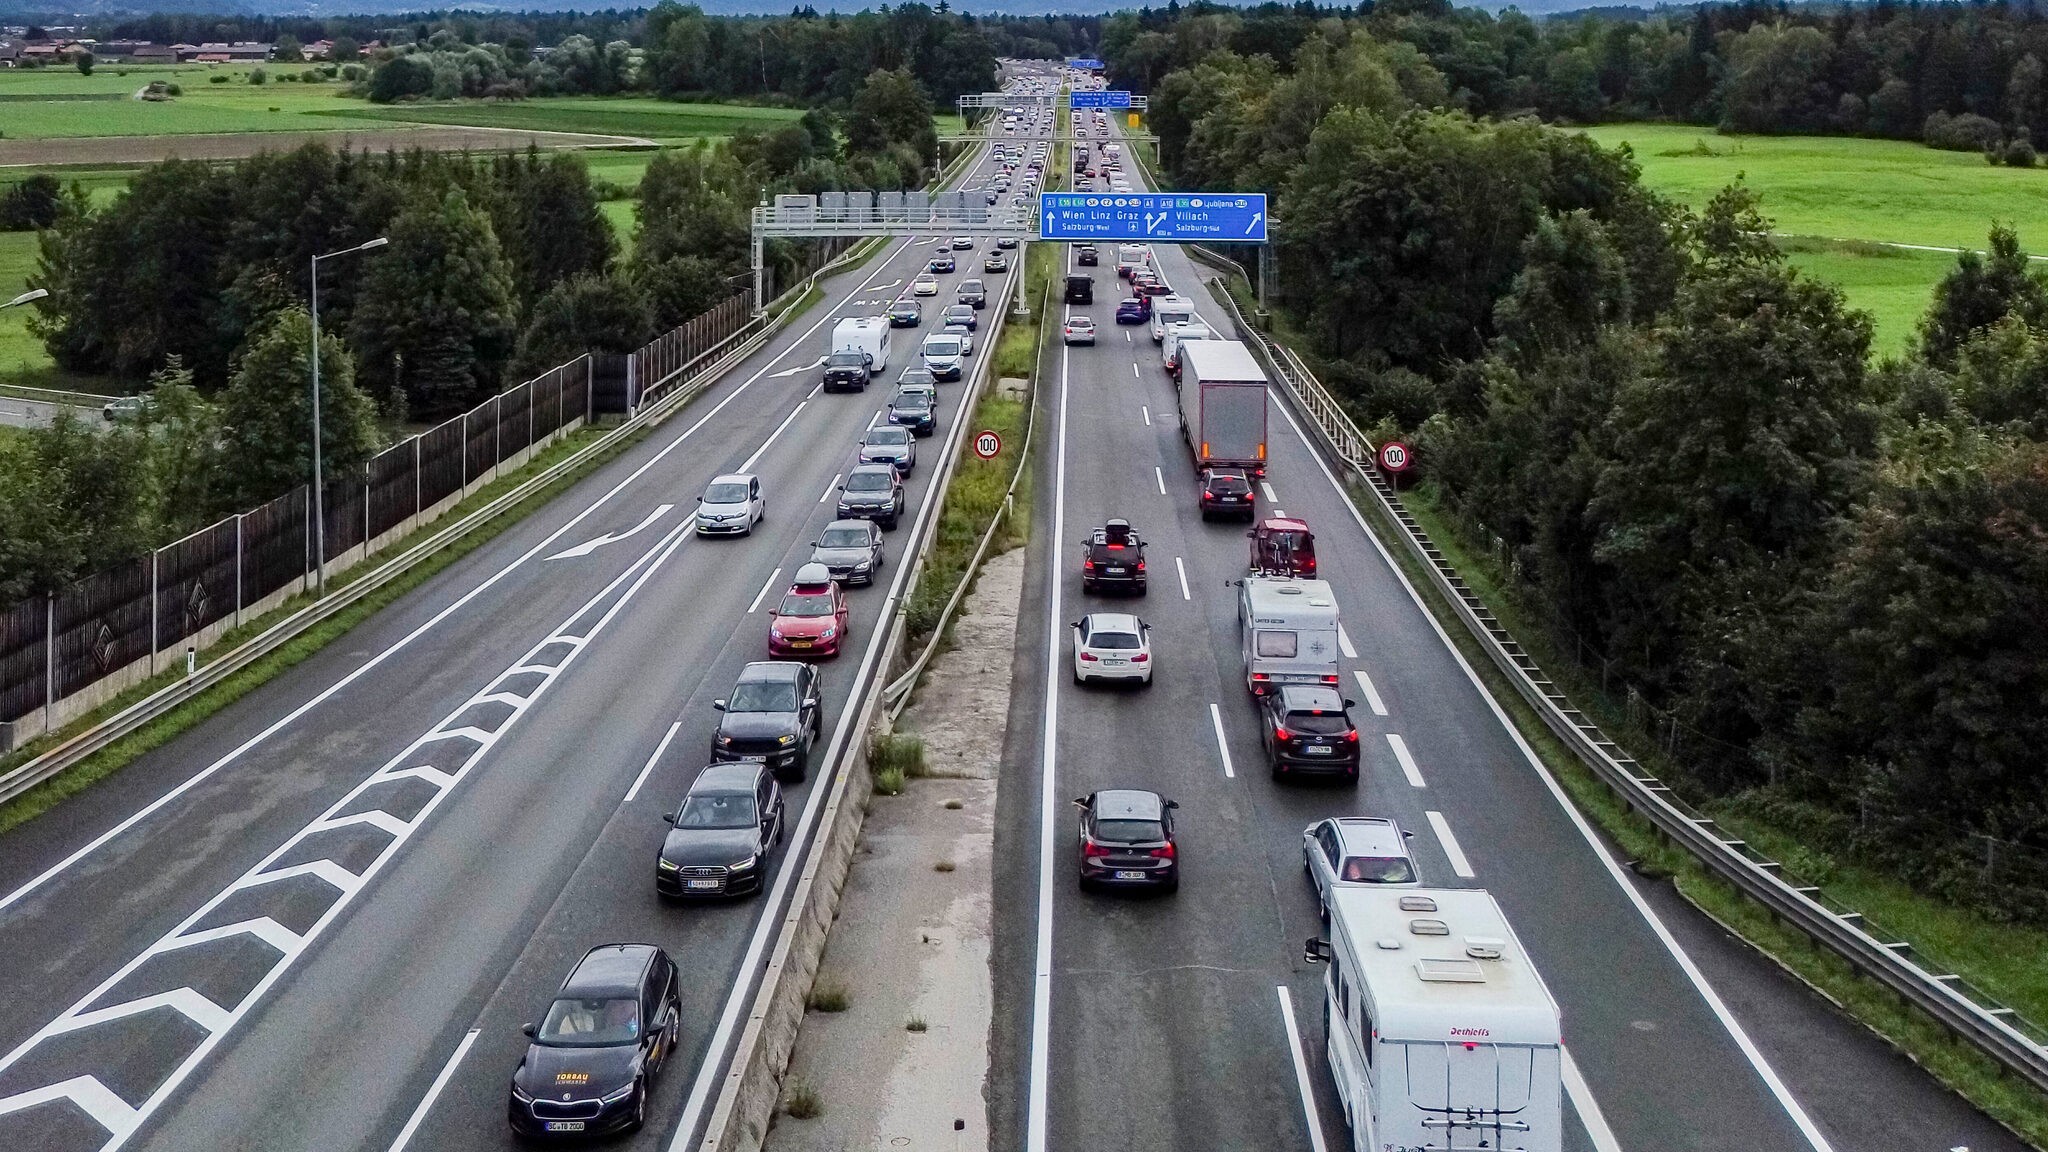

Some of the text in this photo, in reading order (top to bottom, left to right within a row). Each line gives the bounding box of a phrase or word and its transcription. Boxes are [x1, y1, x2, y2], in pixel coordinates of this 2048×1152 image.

[1204, 199, 1234, 208] Ljubljana
[1062, 210, 1139, 220] Wien Linz Graz
[1176, 211, 1208, 221] Villach
[979, 438, 996, 452] 100
[1386, 449, 1404, 464] 100
[1450, 1027, 1489, 1037] Dethleffs
